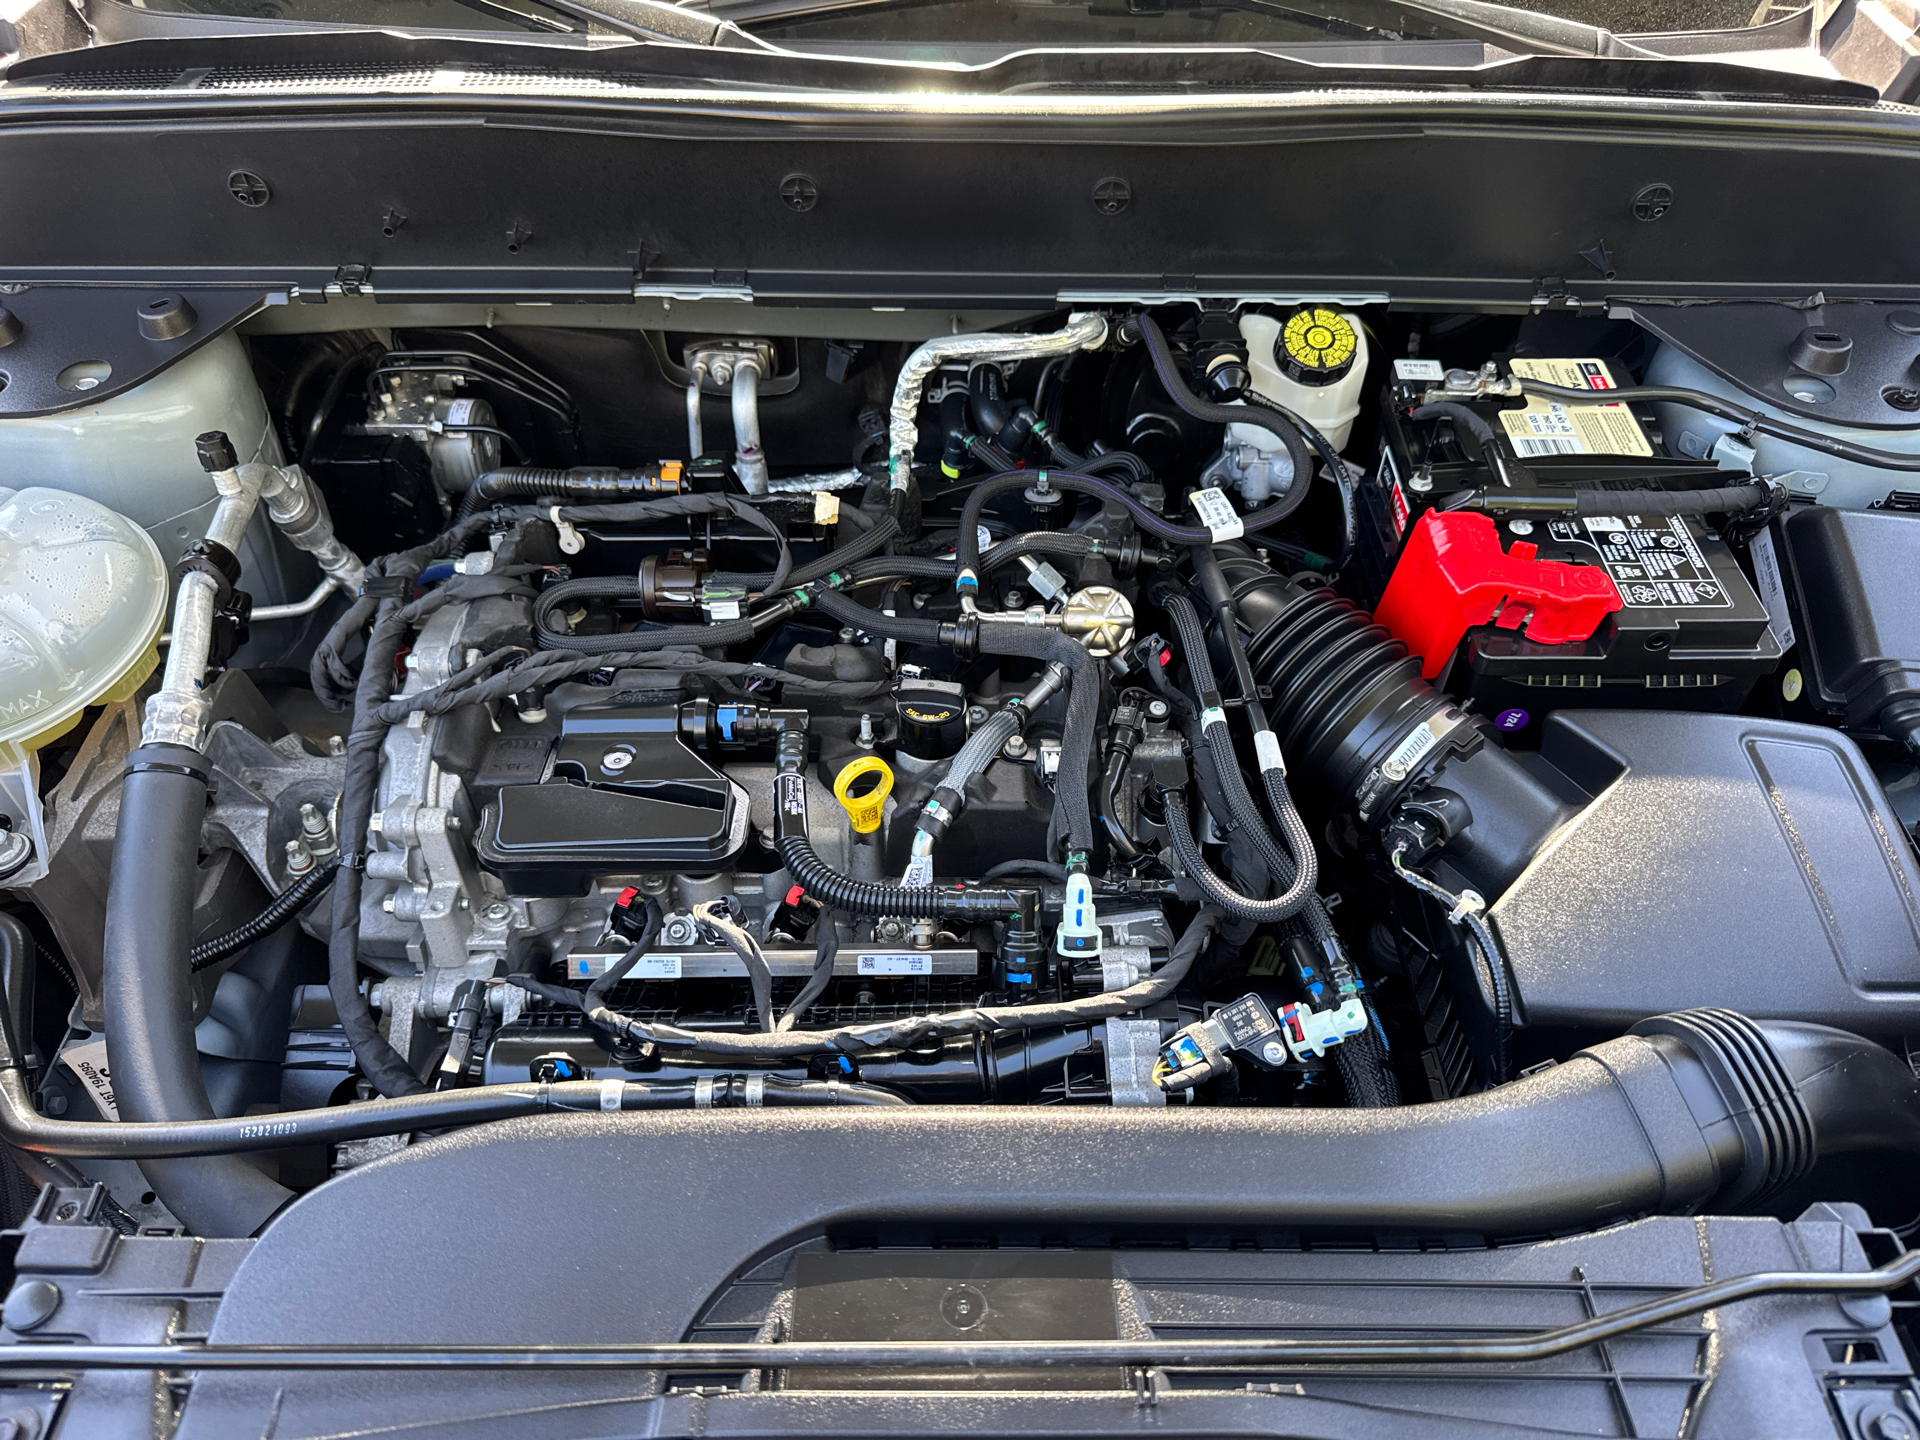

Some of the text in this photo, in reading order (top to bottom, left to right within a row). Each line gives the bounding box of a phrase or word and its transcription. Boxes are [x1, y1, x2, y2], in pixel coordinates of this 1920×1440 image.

[1338, 465, 1350, 490] DATE
[0, 689, 50, 720] MAX
[905, 707, 950, 721] SAE 5W-20
[1503, 712, 1523, 728] 7/24
[77, 1061, 106, 1089] 19A095
[239, 1122, 298, 1139] 152821093
